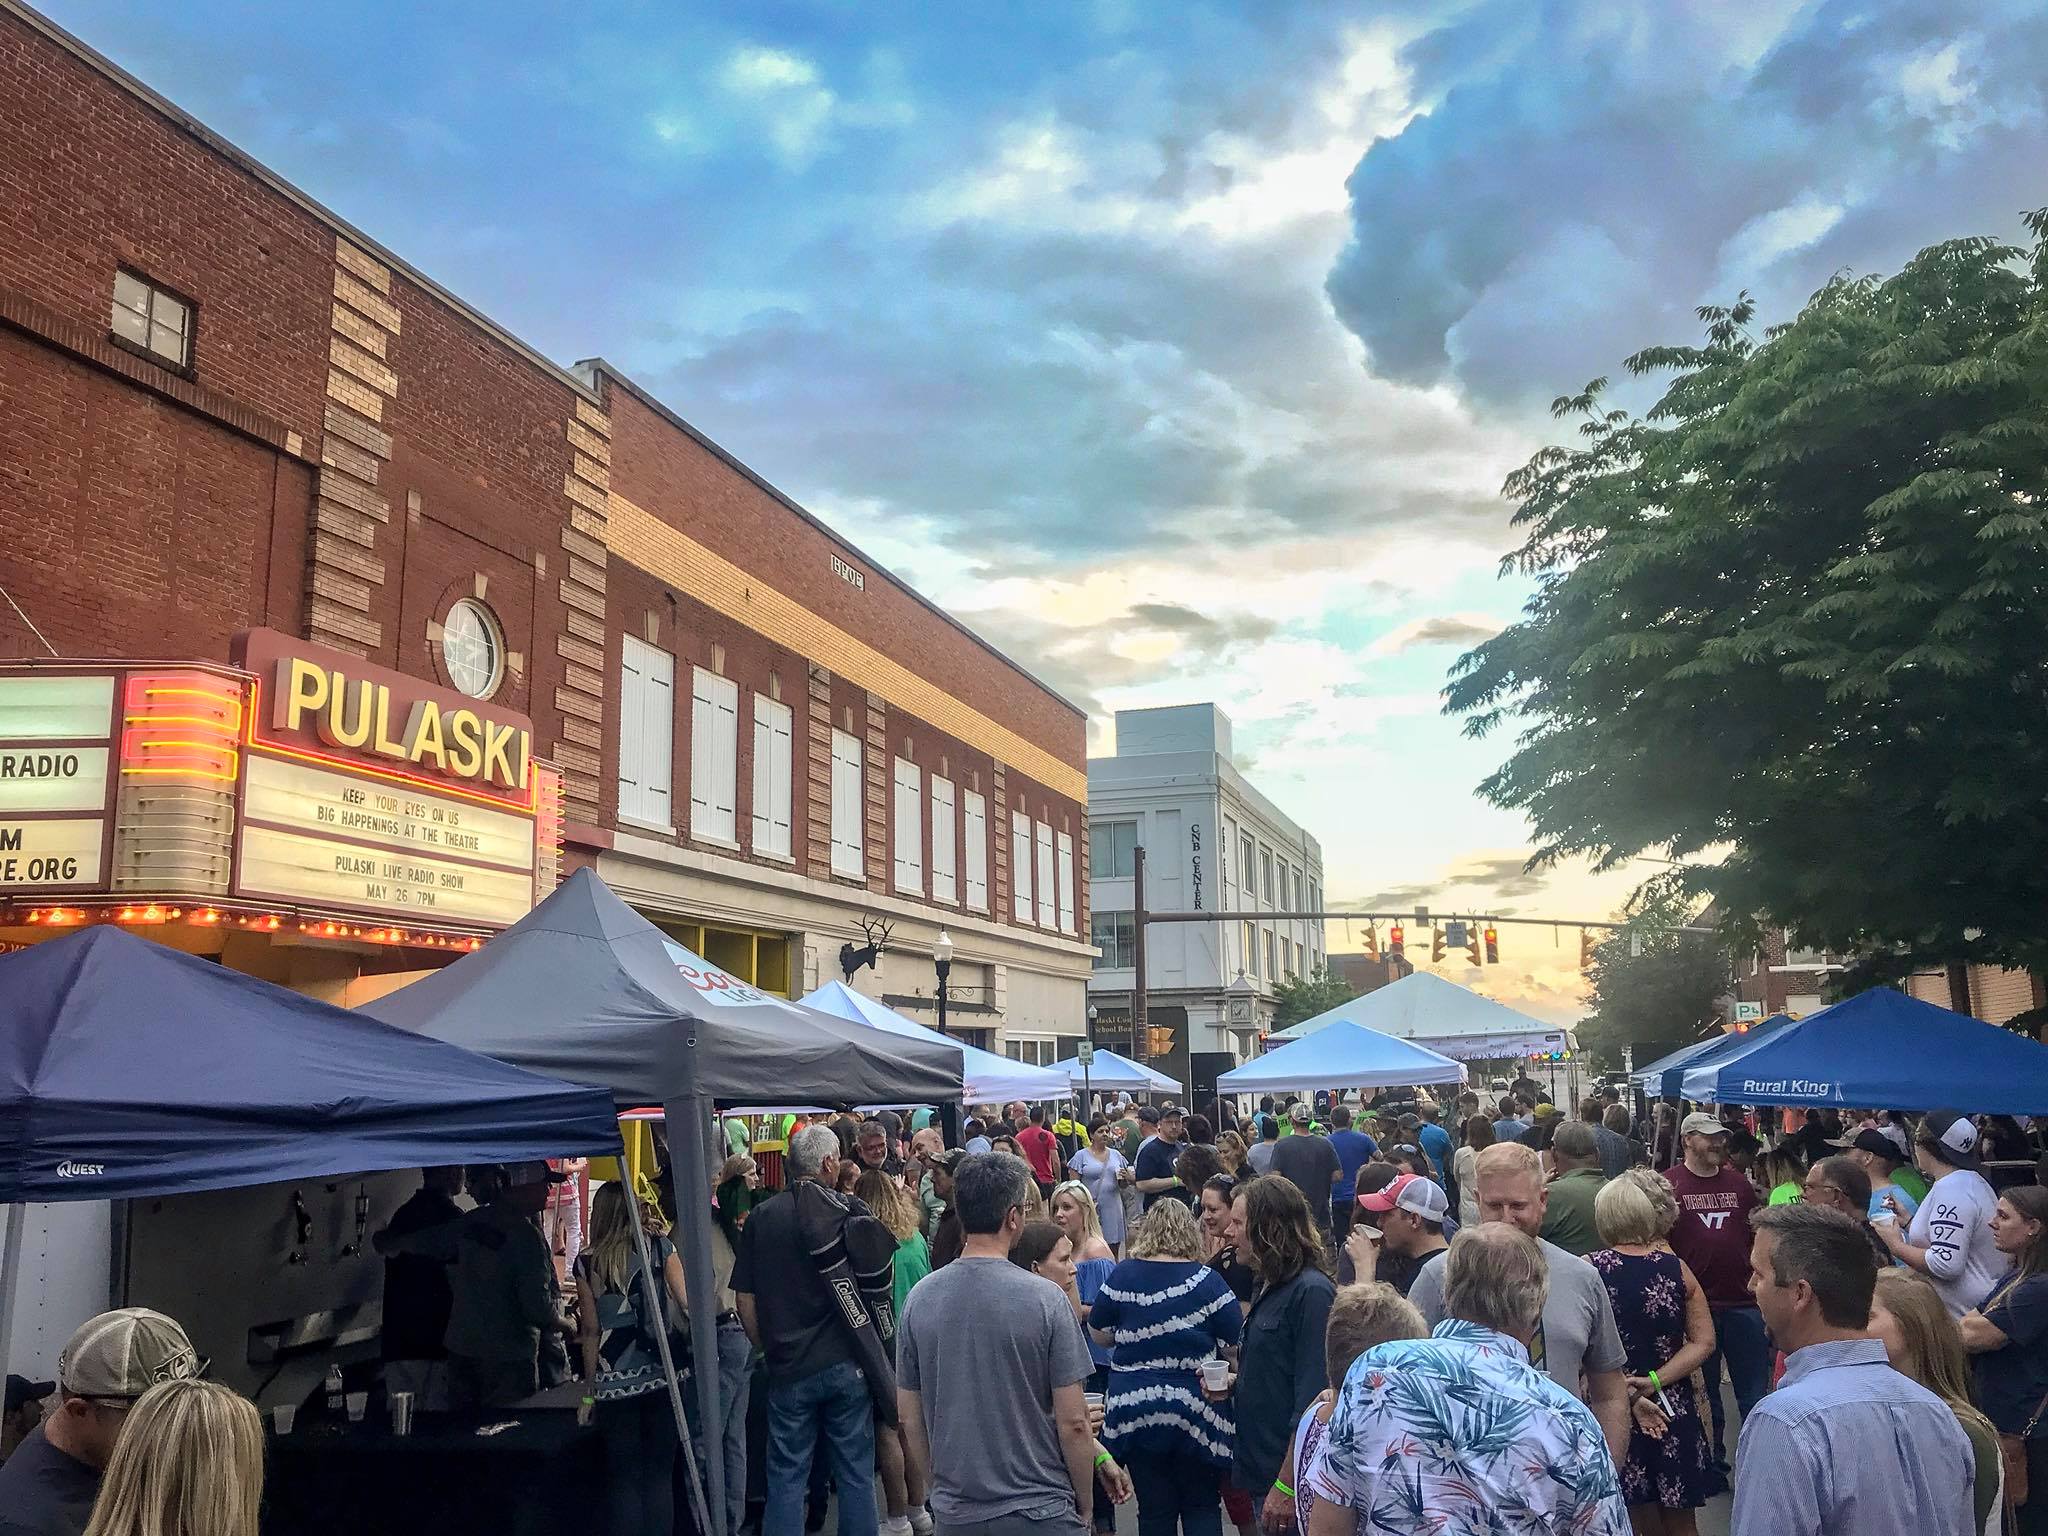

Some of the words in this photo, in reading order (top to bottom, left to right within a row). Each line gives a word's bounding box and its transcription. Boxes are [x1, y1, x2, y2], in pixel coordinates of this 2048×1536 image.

[832, 556, 862, 588] BPOE
[275, 657, 529, 789] PULASKI
[1, 755, 79, 778] RADIO
[343, 787, 365, 805] KEEP
[376, 792, 398, 812] YOUR
[405, 801, 425, 819] EYES
[432, 808, 444, 824] ON
[449, 810, 459, 825] US
[317, 806, 335, 822] BIG
[341, 810, 399, 835] HAPPENINGS
[404, 824, 416, 839] AT
[422, 827, 438, 843] THE
[444, 831, 479, 851] THEATRE
[1191, 824, 1200, 851] CNB
[0, 857, 77, 881] E.ORG
[336, 855, 376, 876] PULASKI
[383, 863, 402, 880] LIVE
[408, 869, 435, 886] RADIO
[441, 873, 464, 890] SHOW
[366, 884, 387, 900] MAY
[396, 888, 408, 903] 26
[417, 891, 435, 906] 7PM
[1192, 856, 1203, 910] CENTER
[1743, 1080, 1786, 1092] Rural
[1791, 1080, 1828, 1096] King
[57, 1160, 104, 1178] QUEST
[1682, 1194, 1719, 1210] VIRGINIA
[1936, 1204, 1958, 1220] 96
[1698, 1211, 1731, 1229] VT
[1934, 1226, 1955, 1240] 97
[836, 1282, 860, 1317] Coleman
